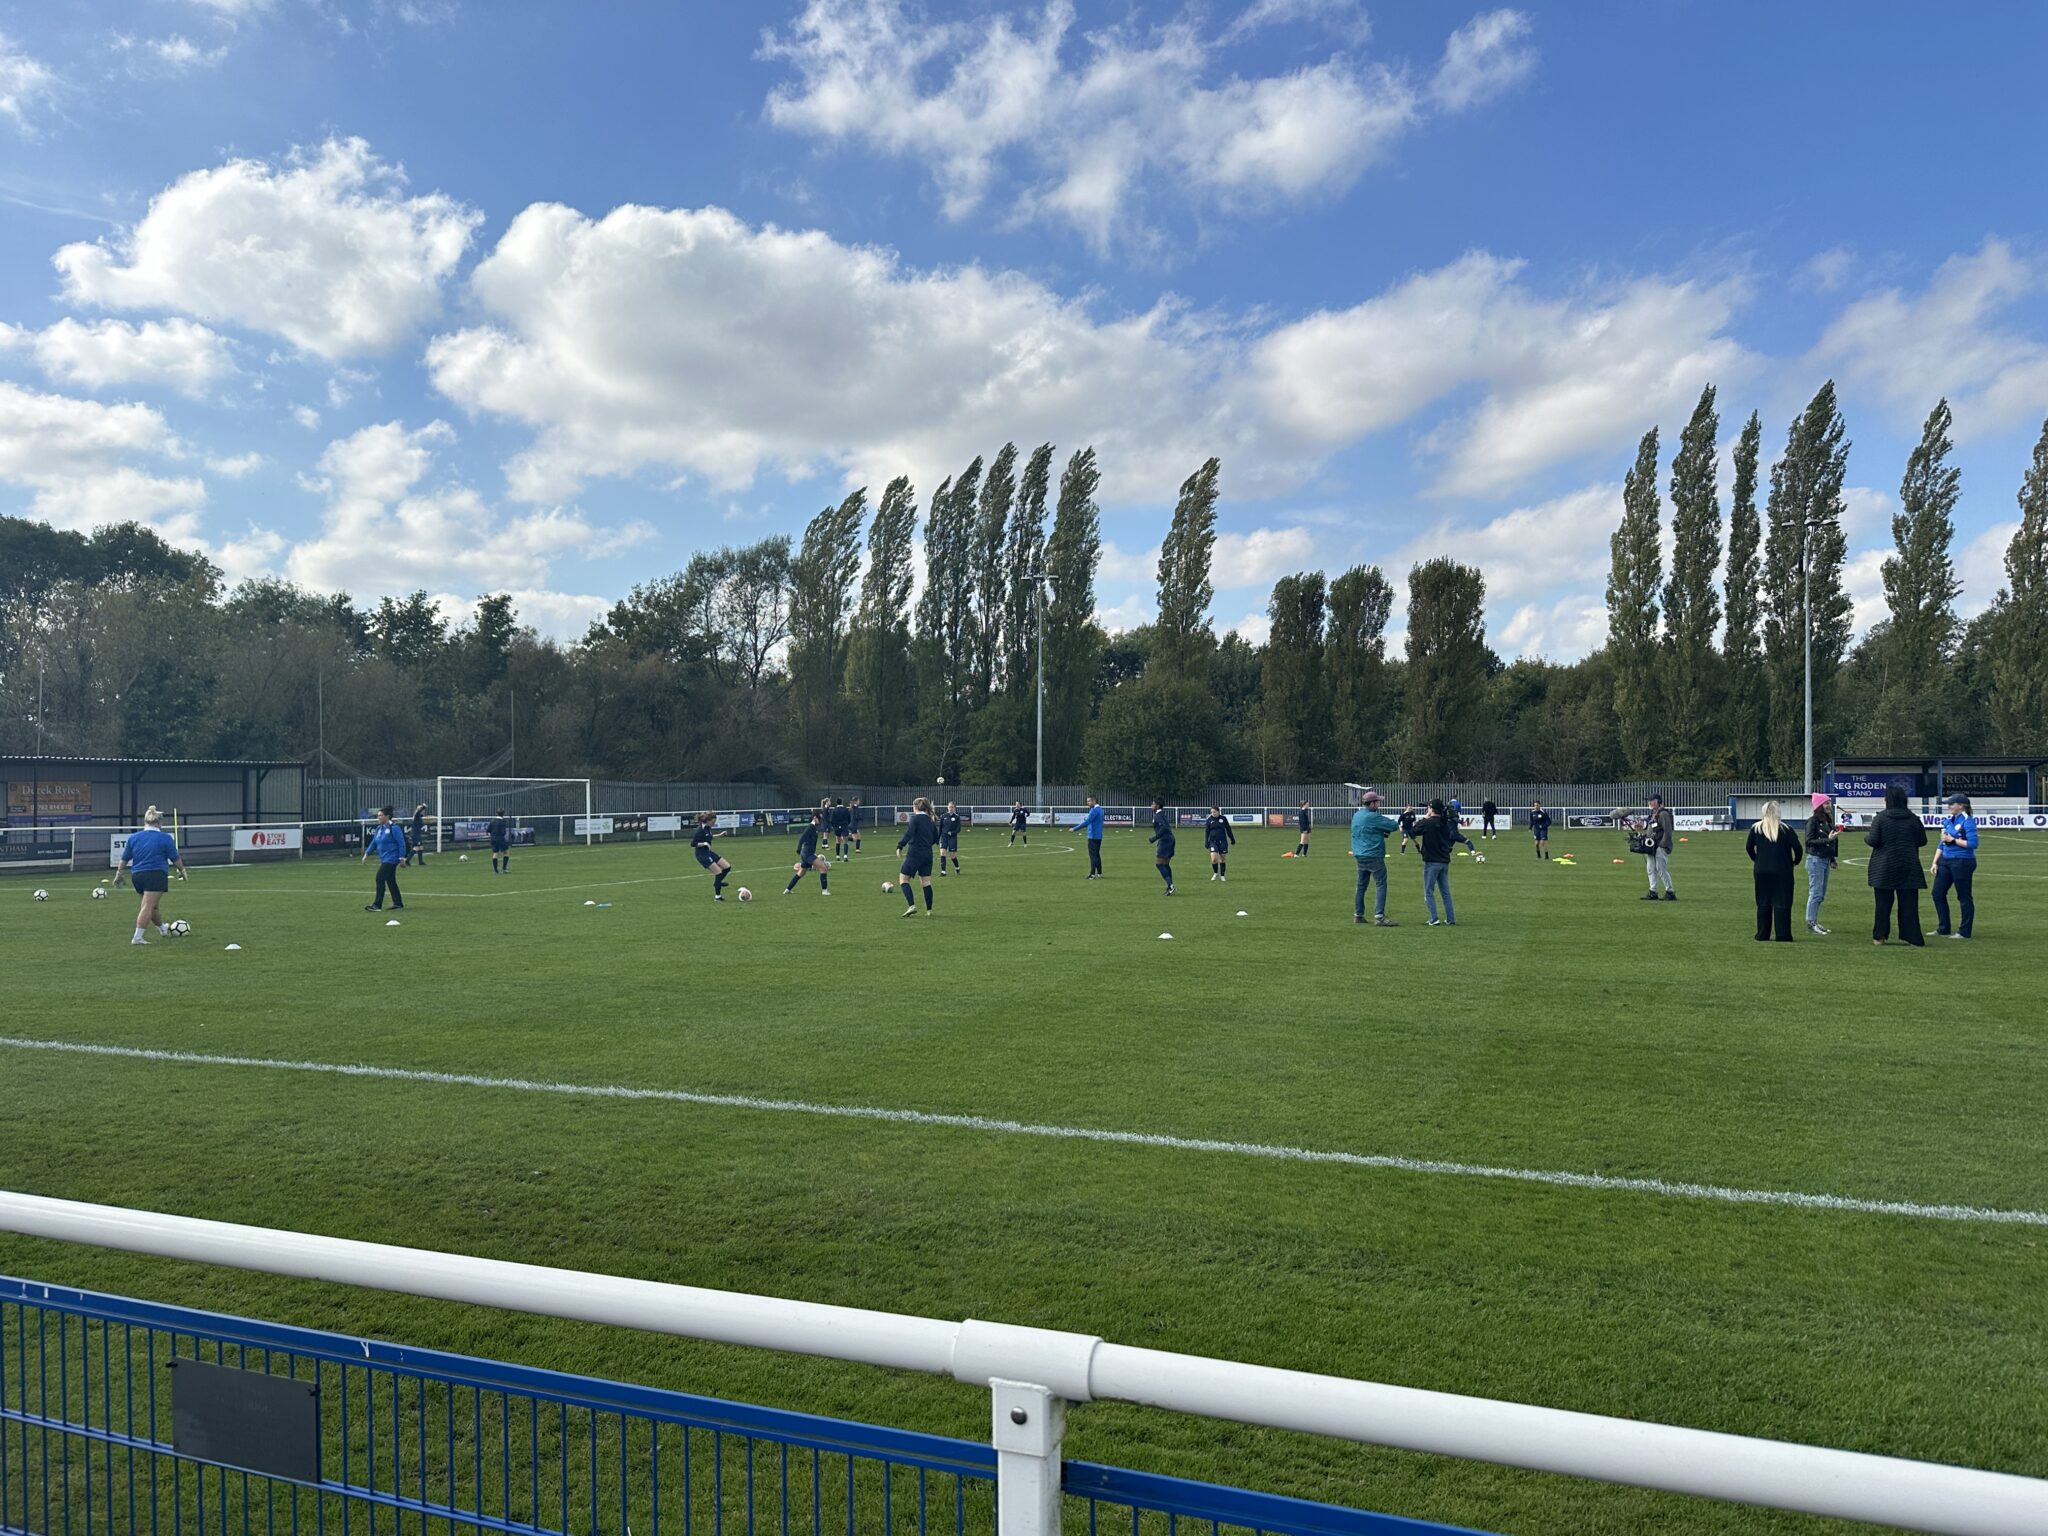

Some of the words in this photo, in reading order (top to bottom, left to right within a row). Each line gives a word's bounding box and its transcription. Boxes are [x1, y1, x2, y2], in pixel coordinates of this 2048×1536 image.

[55, 785, 81, 797] Ryles
[1853, 782, 1887, 790] RODEN
[1988, 815, 2025, 827] Speak
[266, 838, 287, 847] EATS
